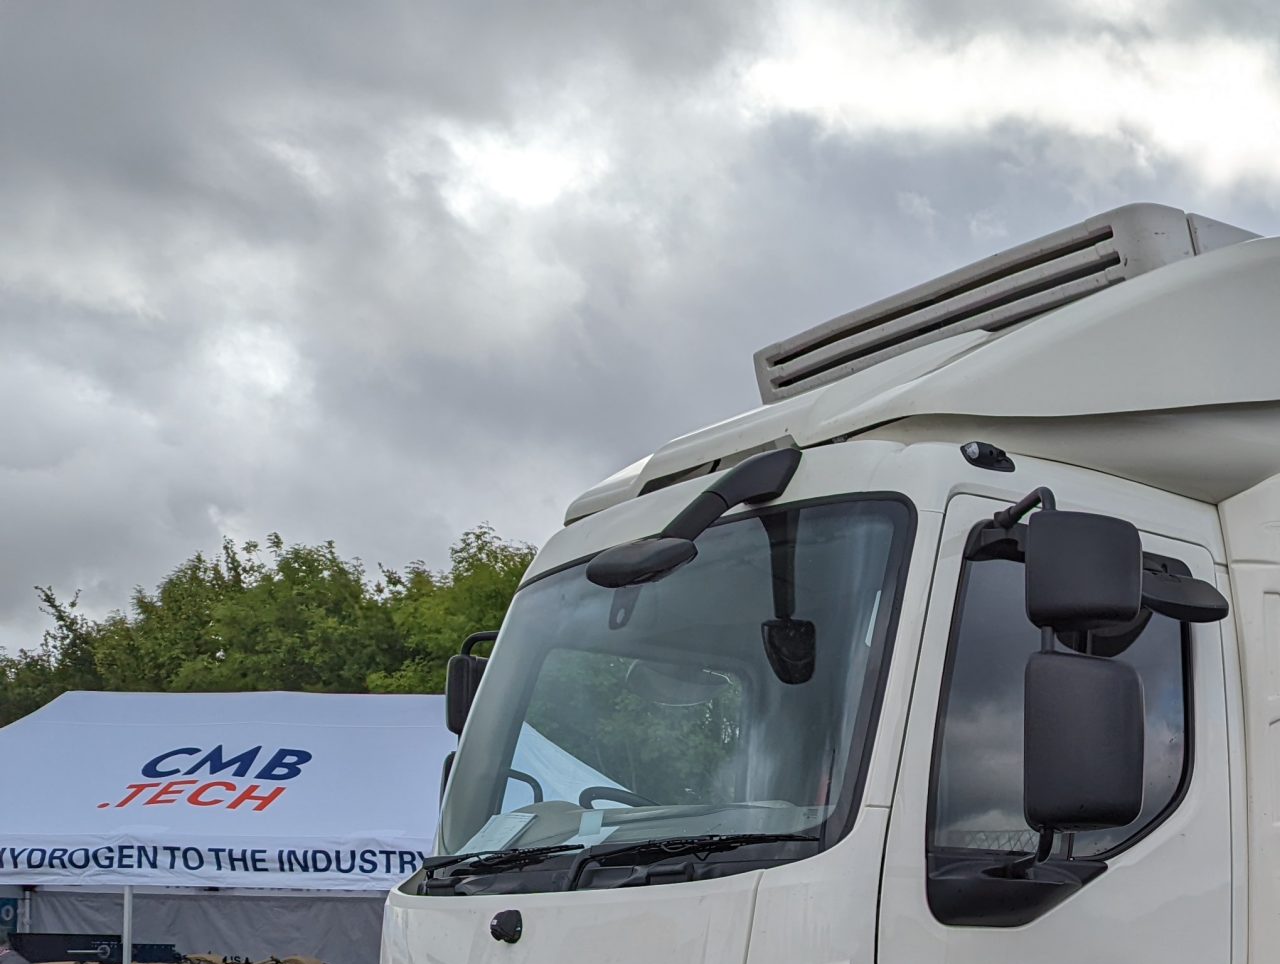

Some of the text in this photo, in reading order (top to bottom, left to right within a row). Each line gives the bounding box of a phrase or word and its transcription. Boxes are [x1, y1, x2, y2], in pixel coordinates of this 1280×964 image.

[141, 744, 313, 781] CMB
[97, 780, 287, 812] .TECH
[163, 846, 205, 871] TO
[207, 848, 267, 872] THE
[277, 849, 425, 874] INDUSTR
